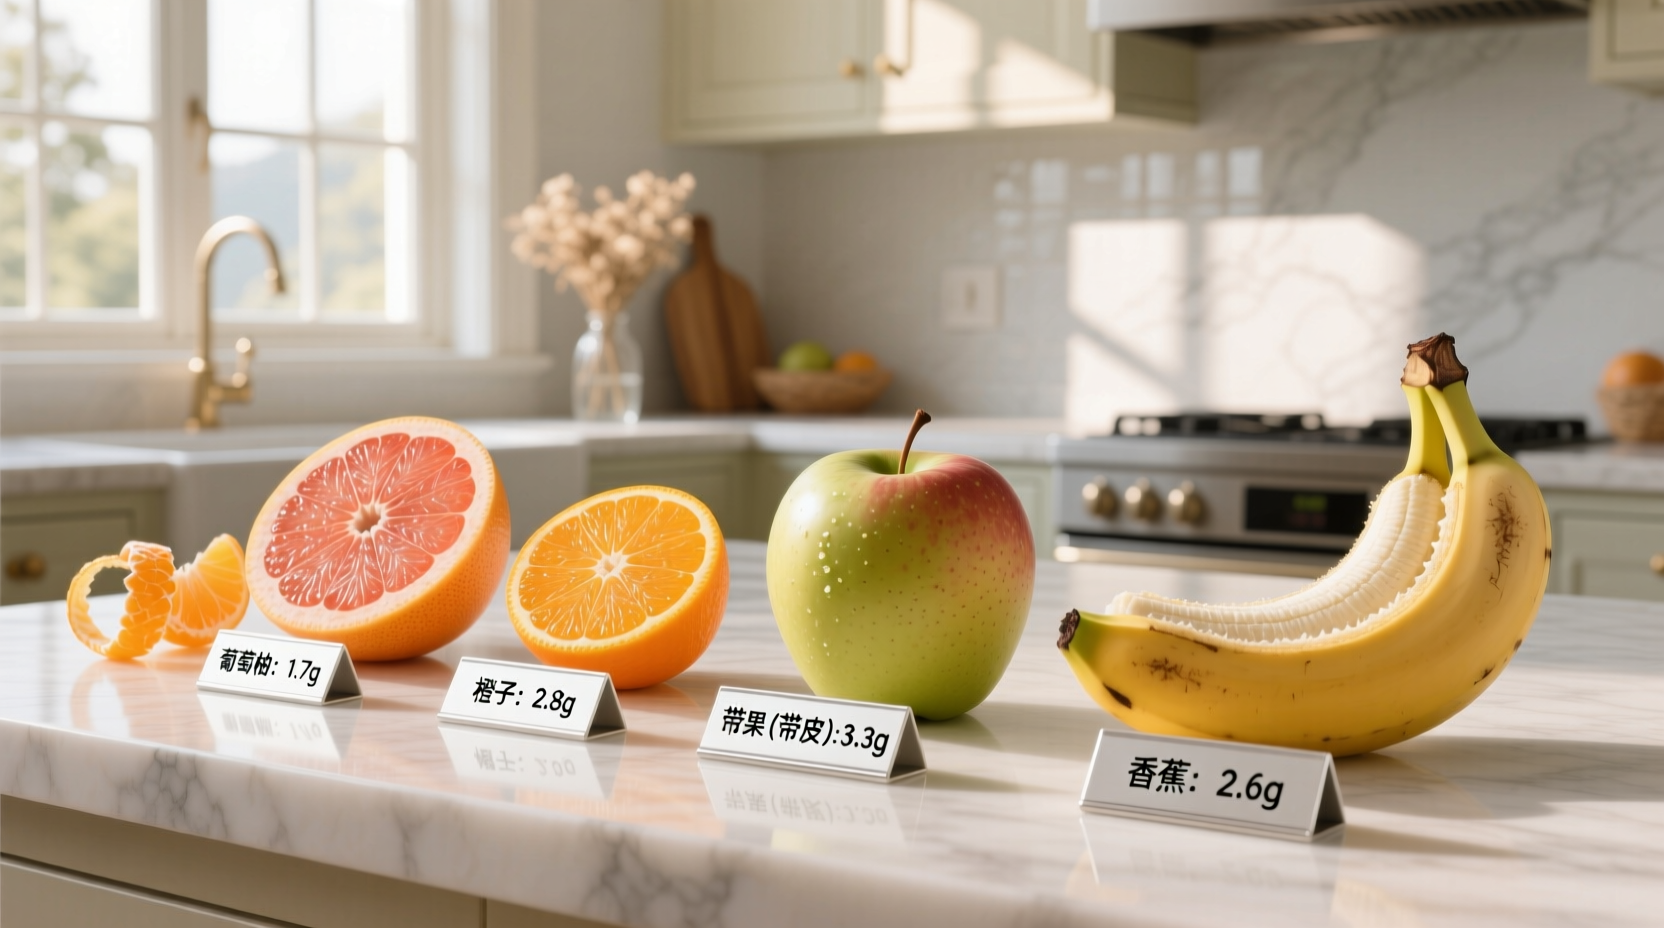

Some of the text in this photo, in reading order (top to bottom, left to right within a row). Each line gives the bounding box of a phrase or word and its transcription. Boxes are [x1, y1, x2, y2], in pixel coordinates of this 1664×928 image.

[287, 658, 321, 688] 1.7g
[531, 687, 576, 719] 2.8g
[1216, 768, 1284, 811] 2.6g
